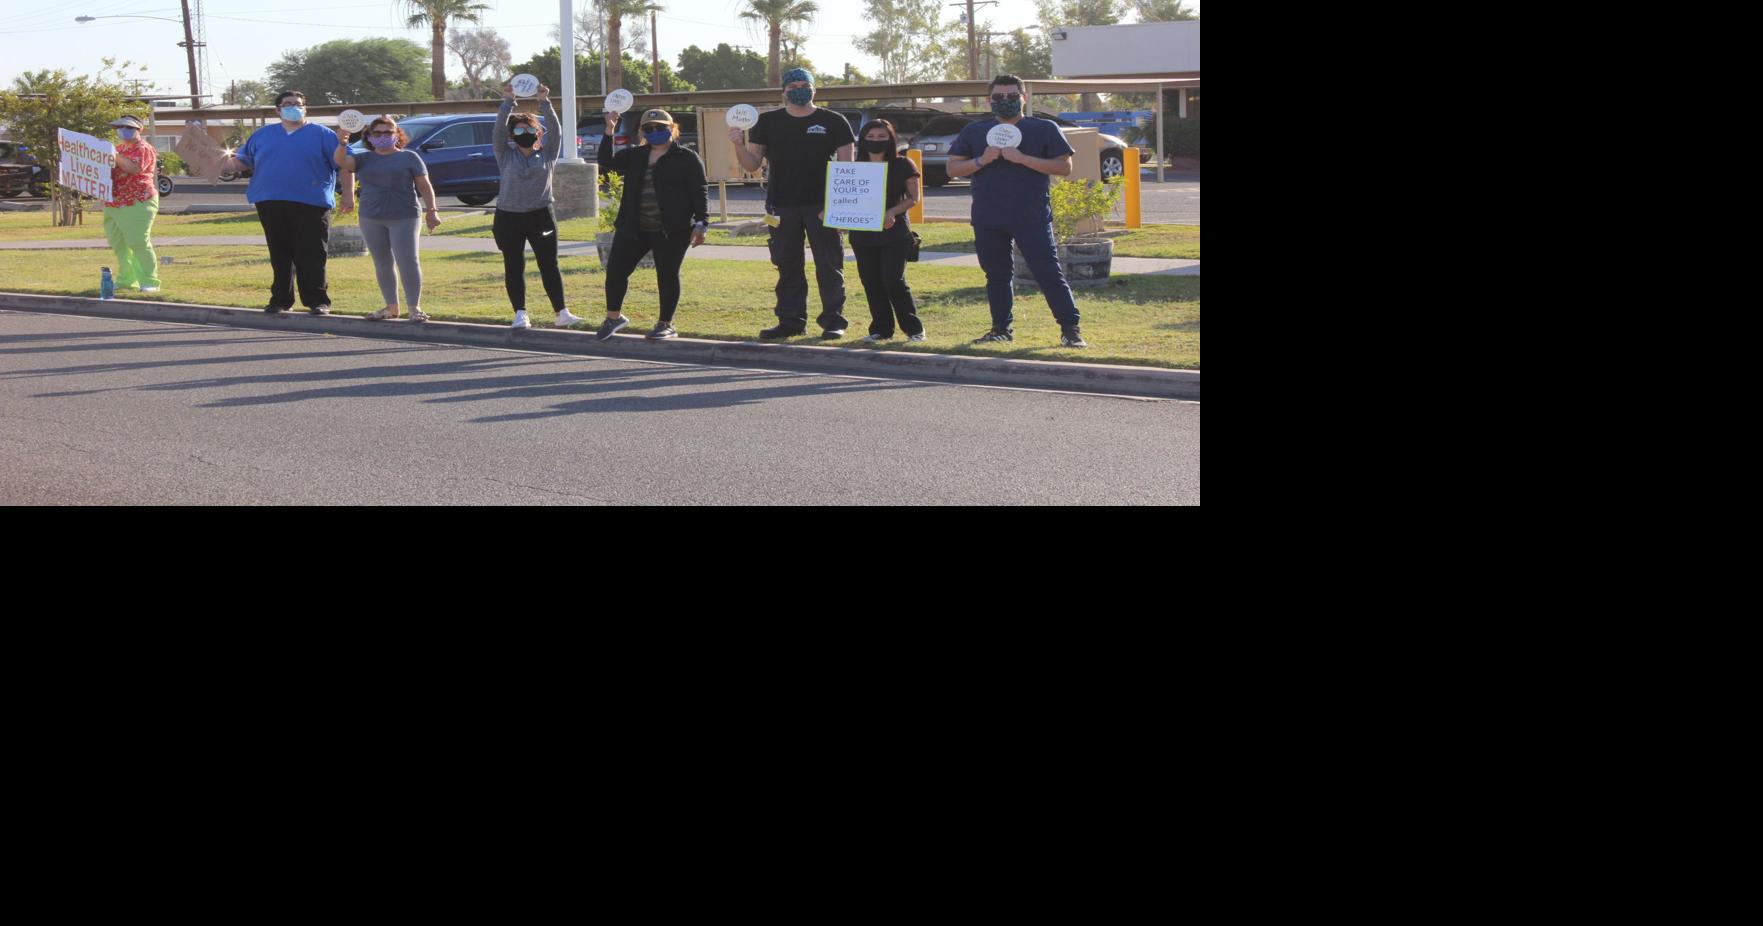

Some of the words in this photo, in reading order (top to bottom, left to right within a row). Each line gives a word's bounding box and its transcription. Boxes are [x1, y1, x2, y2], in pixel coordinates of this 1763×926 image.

[58, 136, 115, 168] Healthcare
[70, 155, 99, 180] Lives
[834, 167, 857, 175] TAKE
[61, 169, 110, 201] MATTER!
[833, 178, 856, 186] CARE
[832, 186, 857, 194] YOUR
[832, 197, 858, 205] called
